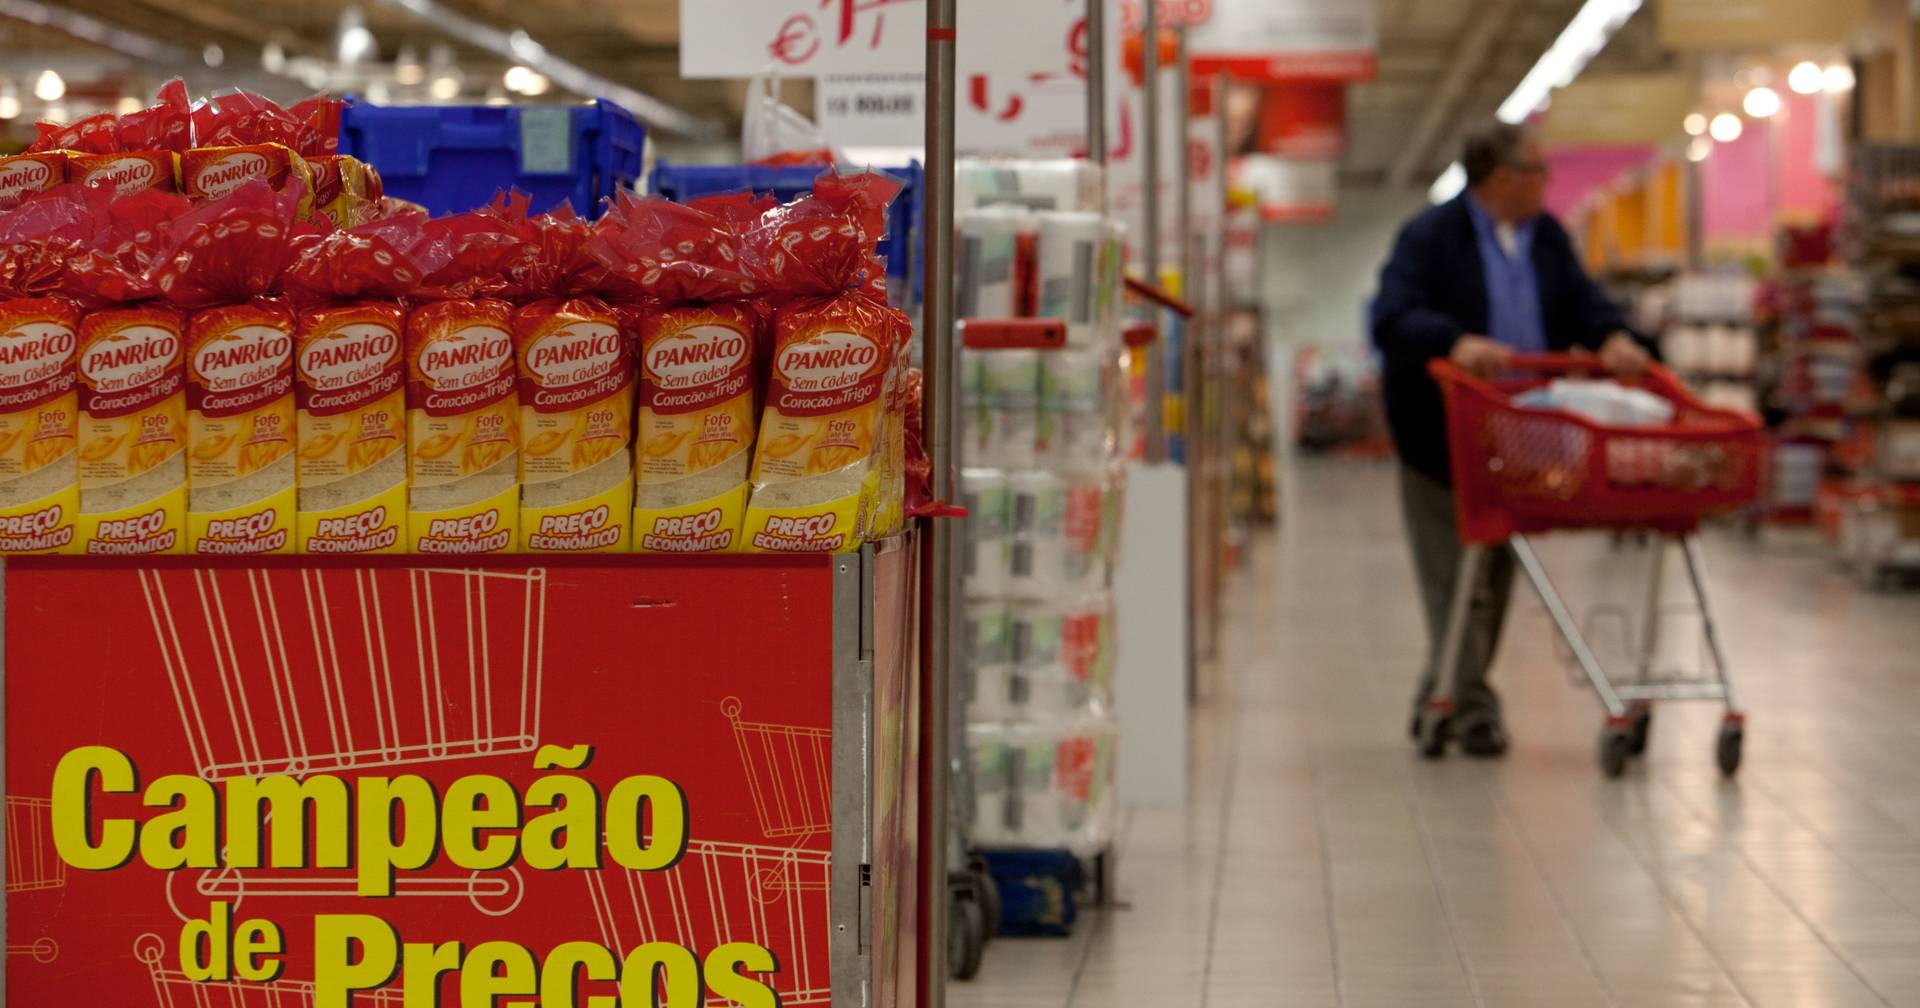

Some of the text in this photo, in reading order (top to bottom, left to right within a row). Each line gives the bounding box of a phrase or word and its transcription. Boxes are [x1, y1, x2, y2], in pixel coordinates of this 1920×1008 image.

[0, 389, 38, 405] oração
[48, 372, 76, 391] Trigo
[100, 378, 124, 390] Sem
[212, 377, 236, 389] Sem
[309, 392, 360, 408] Coração
[368, 372, 398, 393] Trigo
[319, 375, 342, 388] Sem
[436, 376, 459, 388] Sem
[534, 390, 586, 405] Coração
[595, 371, 624, 393] Trigo
[545, 372, 569, 385] Sem
[652, 391, 706, 406] Coração
[714, 375, 744, 396] Trigo
[663, 374, 688, 387] Sem
[792, 376, 817, 389] Sem
[89, 393, 141, 410] Coração
[149, 375, 178, 395] Trigo
[202, 394, 253, 409] Coração
[261, 375, 291, 395] Trigo
[426, 393, 476, 408] Coração
[485, 375, 512, 396] Trigo
[780, 393, 833, 409] Coração
[842, 384, 872, 402] Trigo
[38, 410, 66, 425] Fofo
[142, 412, 168, 427] Fofo
[254, 413, 280, 427] Fofo
[361, 410, 388, 425] Fofo
[476, 413, 503, 427] Fofo
[586, 409, 613, 424] Fofo
[704, 412, 732, 426] Fofo
[828, 419, 856, 432] Fofo
[99, 508, 165, 540] PREÇO
[208, 508, 274, 539] PREÇO
[318, 506, 385, 539] PREÇO
[430, 509, 498, 540] PREÇO
[541, 504, 608, 536] PREÇO
[655, 508, 721, 539] PREÇO
[767, 512, 835, 540] PREÇO
[88, 529, 175, 553] ECONÓMICO
[198, 529, 285, 553] ECONÓMICO
[307, 527, 396, 553] ECONÓMICO
[419, 529, 509, 553] ECONÓMICO
[529, 526, 620, 550] ECONÓMICO
[642, 530, 732, 553] ECONÓMICO
[754, 534, 844, 553] ECONÓMICO
[52, 743, 687, 897] Campeão
[179, 900, 284, 982] de
